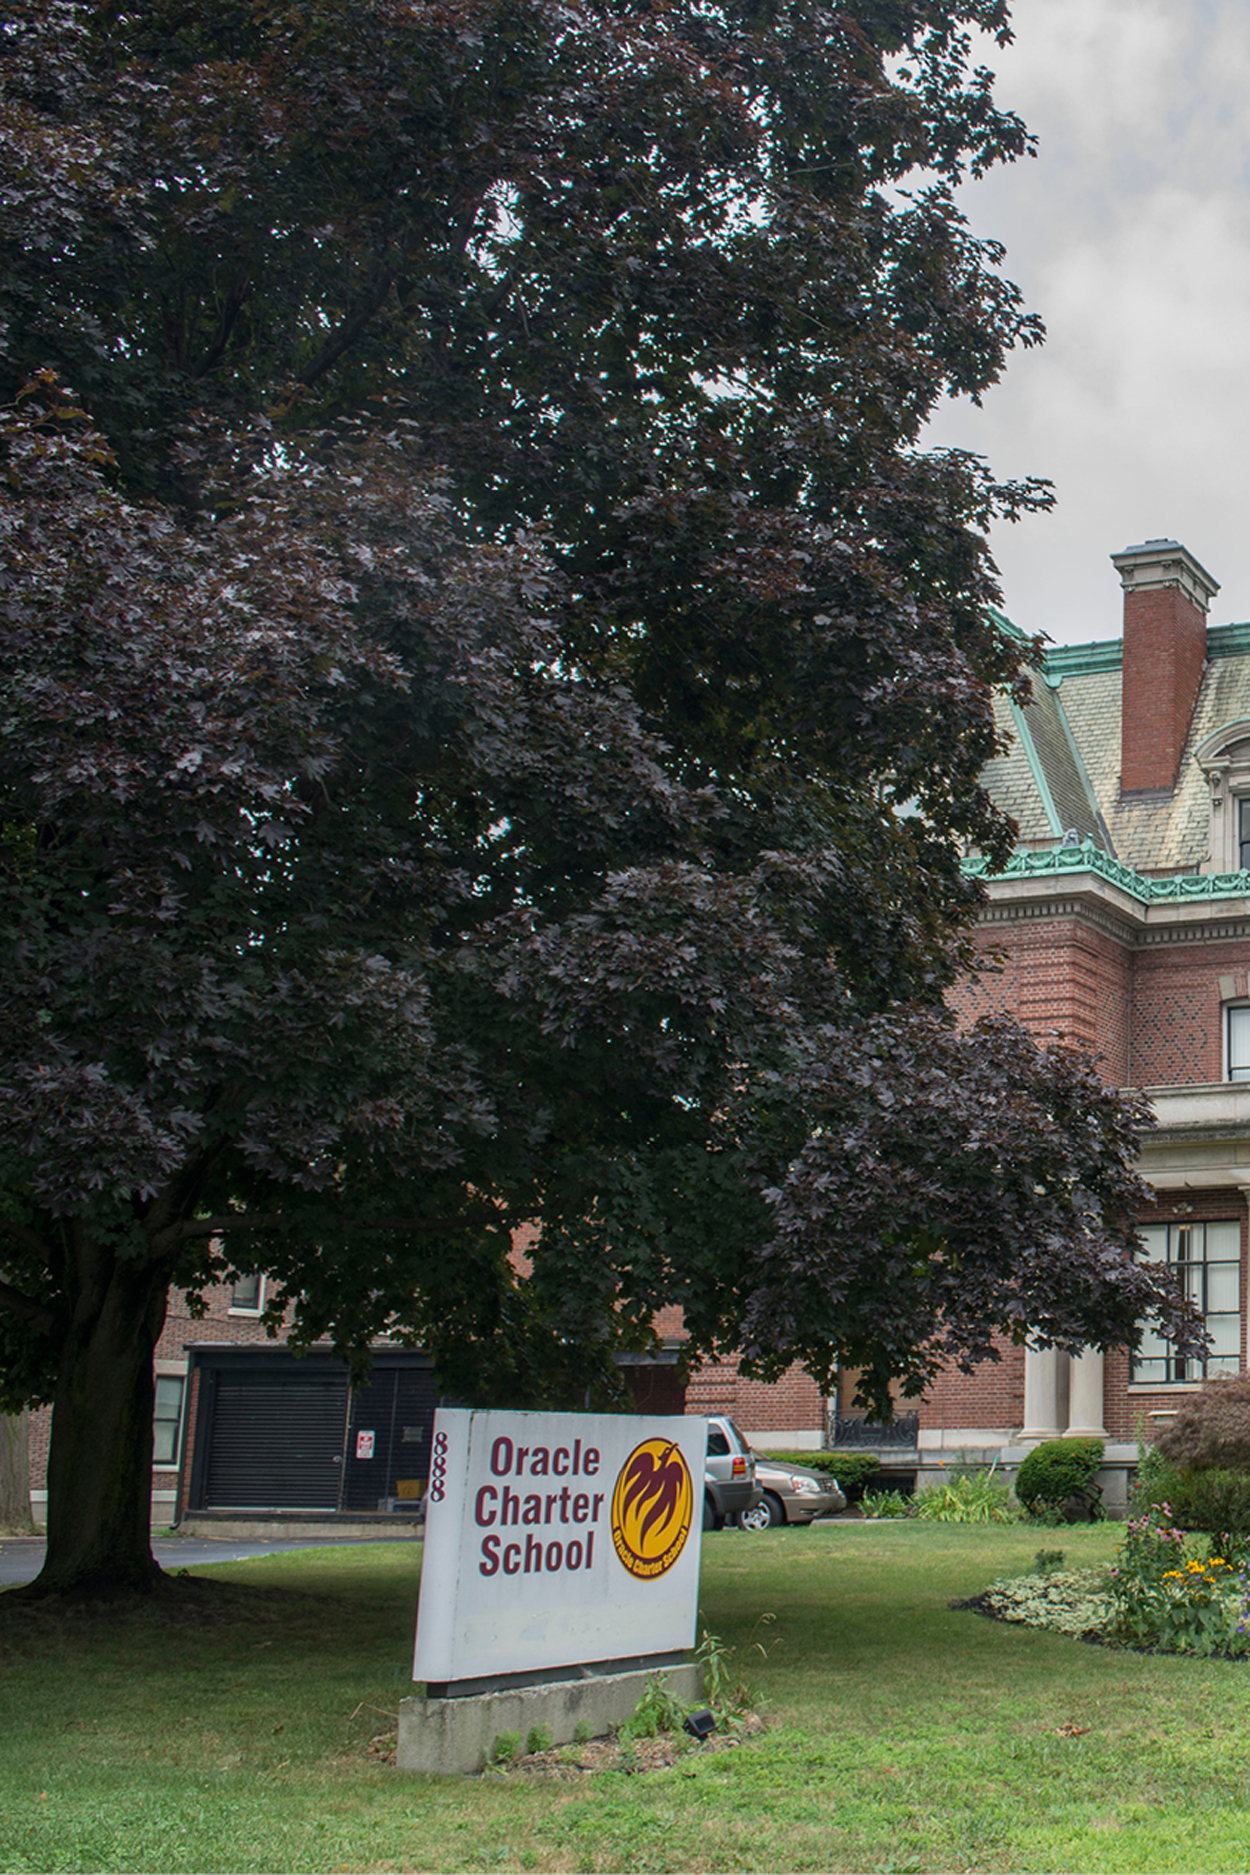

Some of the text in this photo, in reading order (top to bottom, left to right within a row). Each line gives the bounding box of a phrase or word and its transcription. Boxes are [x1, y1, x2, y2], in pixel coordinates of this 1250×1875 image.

[430, 1431, 448, 1502] 888
[490, 1436, 600, 1477] Oracle
[474, 1484, 605, 1528] Charter
[479, 1530, 594, 1577] School
[613, 1527, 688, 1576] Oracle Charter School
